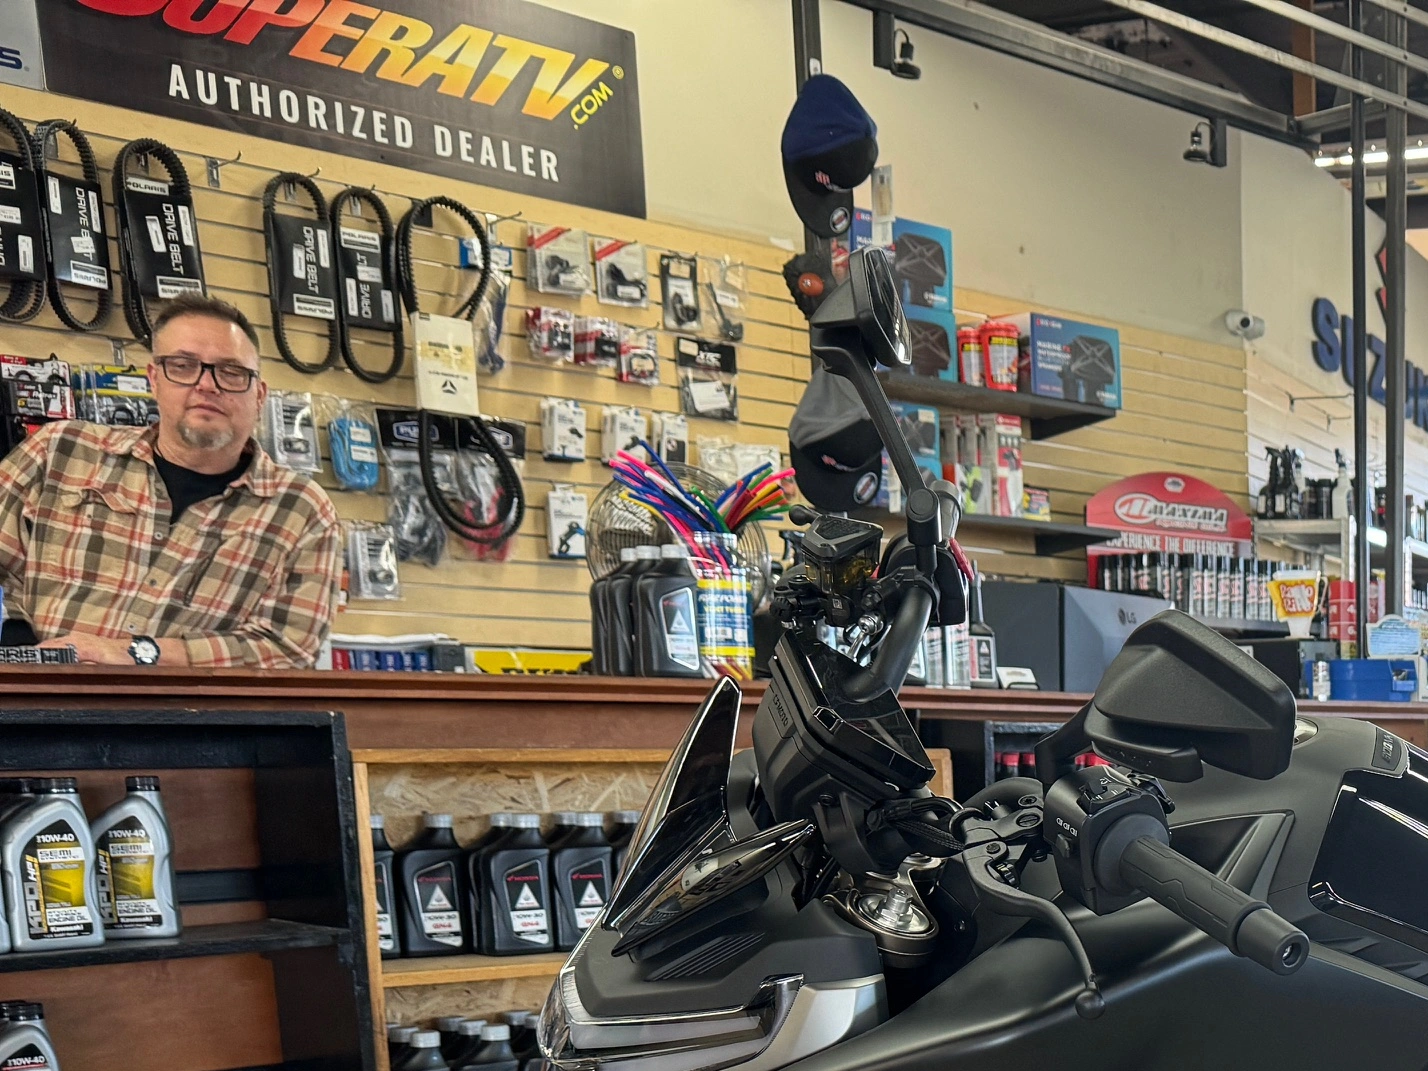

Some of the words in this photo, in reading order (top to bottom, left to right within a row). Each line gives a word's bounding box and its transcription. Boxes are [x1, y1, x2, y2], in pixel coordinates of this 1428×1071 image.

[76, 0, 610, 120] UPERATV
[168, 63, 413, 149] AUTHORIZED
[434, 124, 559, 183] DEALER
[75, 187, 89, 226] DRIVE
[162, 203, 178, 242] DRIVE
[169, 243, 185, 275] BELT
[302, 226, 316, 262] DRIVE
[306, 262, 319, 294] BELT
[359, 283, 372, 319] DRIVE
[41, 833, 75, 843] 10W-40
[113, 829, 147, 839] 10W-40
